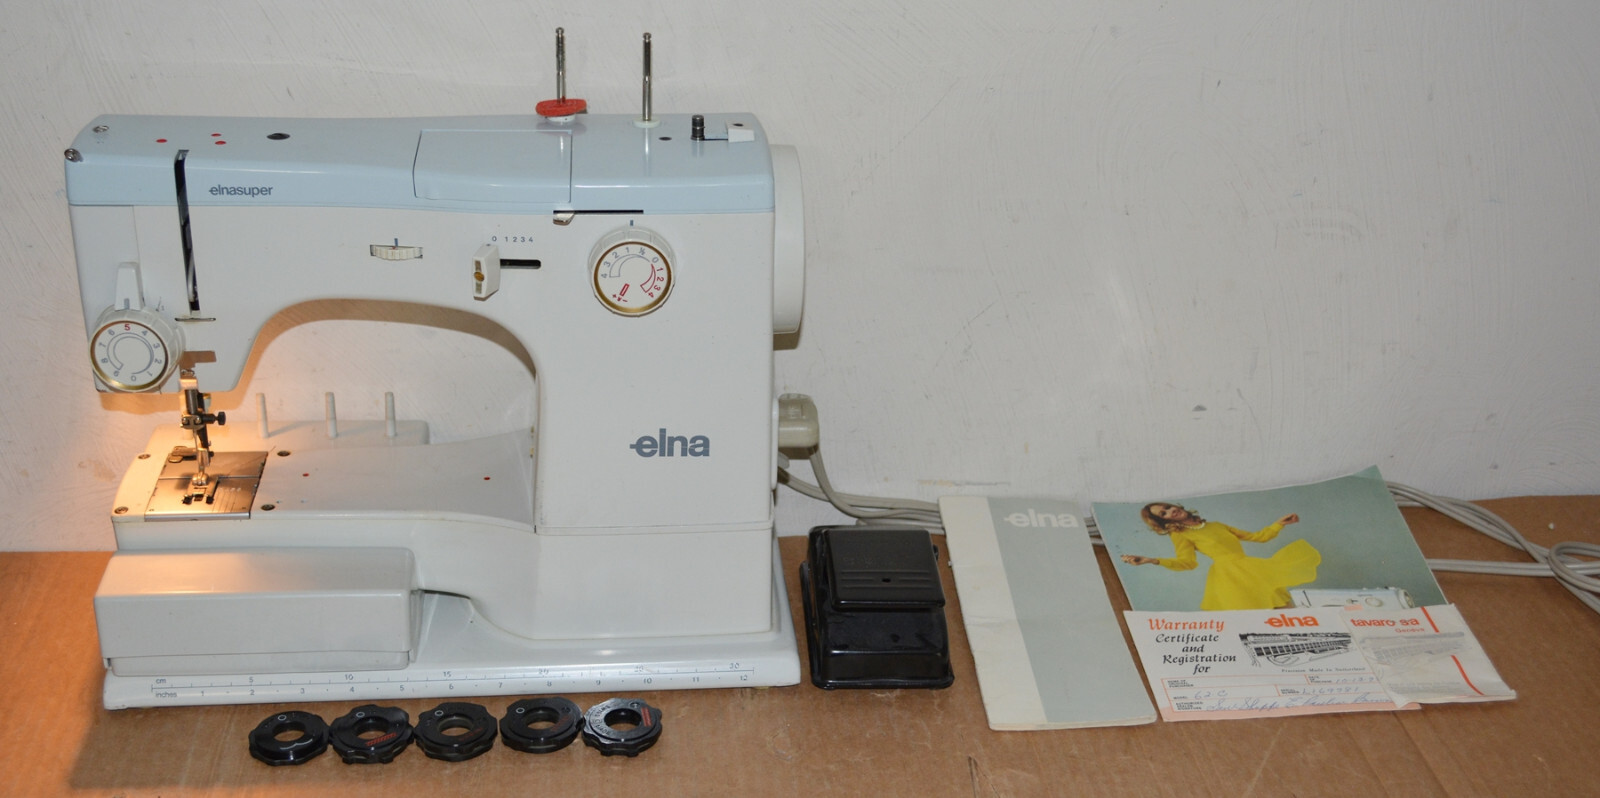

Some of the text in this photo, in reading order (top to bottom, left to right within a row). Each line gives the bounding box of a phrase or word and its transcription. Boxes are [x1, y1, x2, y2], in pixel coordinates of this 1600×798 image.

[612, 251, 620, 259] 2
[1148, 618, 1224, 632] Warranty
[1350, 618, 1419, 626] tavaro sa
[1156, 634, 1219, 643] Certificate
[1182, 644, 1204, 653] and
[1163, 654, 1236, 666] Registration
[1192, 664, 1210, 675] for
